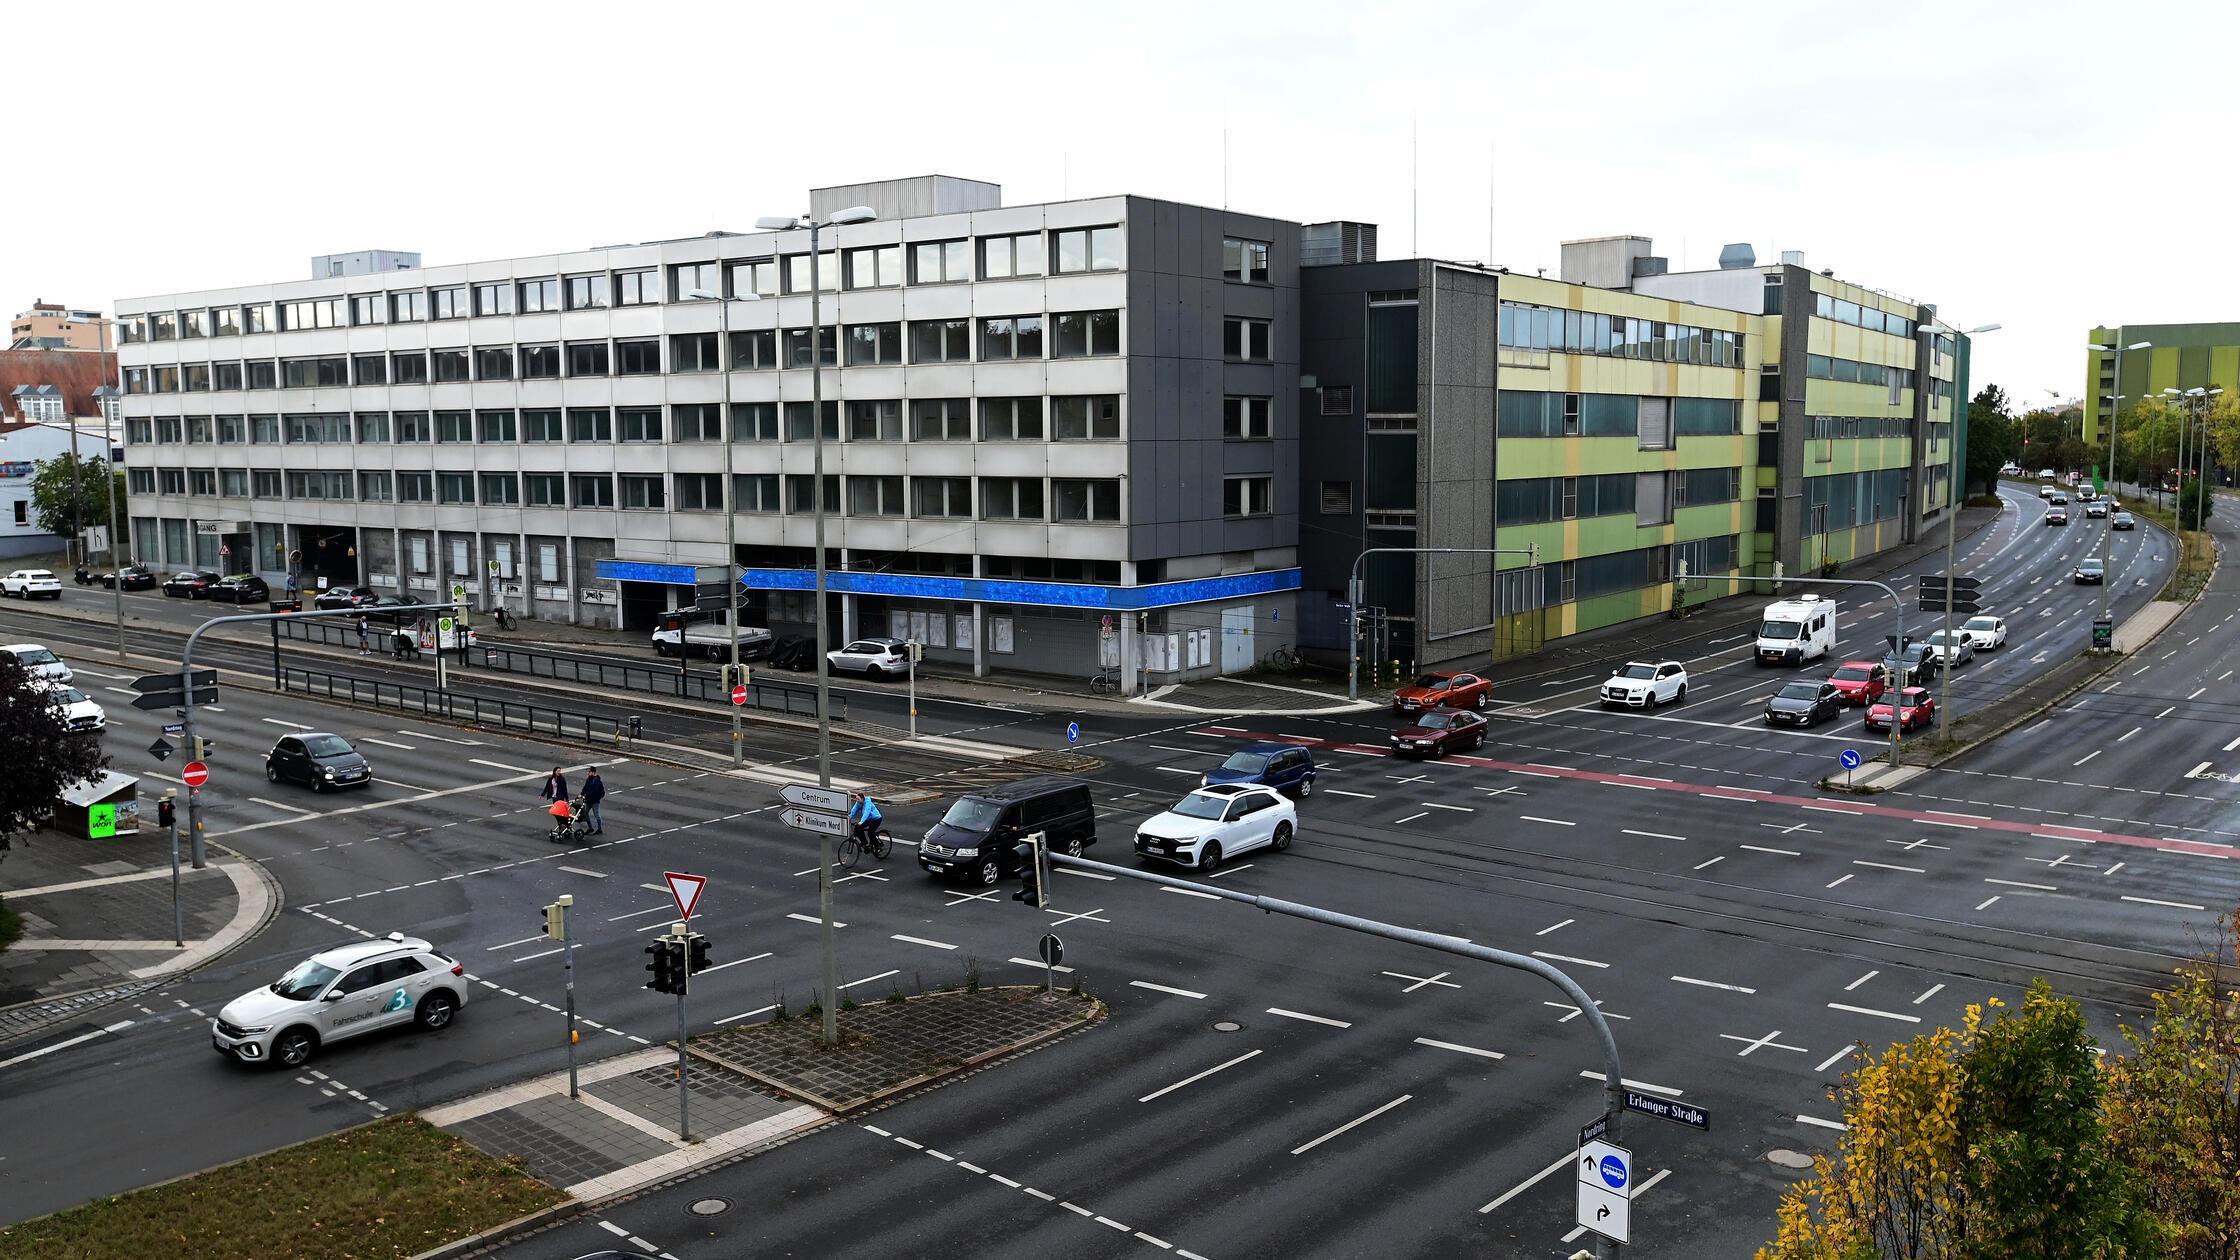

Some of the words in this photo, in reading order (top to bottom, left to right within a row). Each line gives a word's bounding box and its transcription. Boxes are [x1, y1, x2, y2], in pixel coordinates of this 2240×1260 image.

[801, 791, 831, 804] Centrum
[805, 816, 827, 828] Klinikum
[828, 821, 841, 831] Nord
[393, 988, 406, 1010] 3
[333, 1011, 374, 1027] Fahrschule
[1629, 1093, 1669, 1115] Erlanger
[1671, 1104, 1703, 1124] Straße
[1583, 1121, 1606, 1140] Nordring
